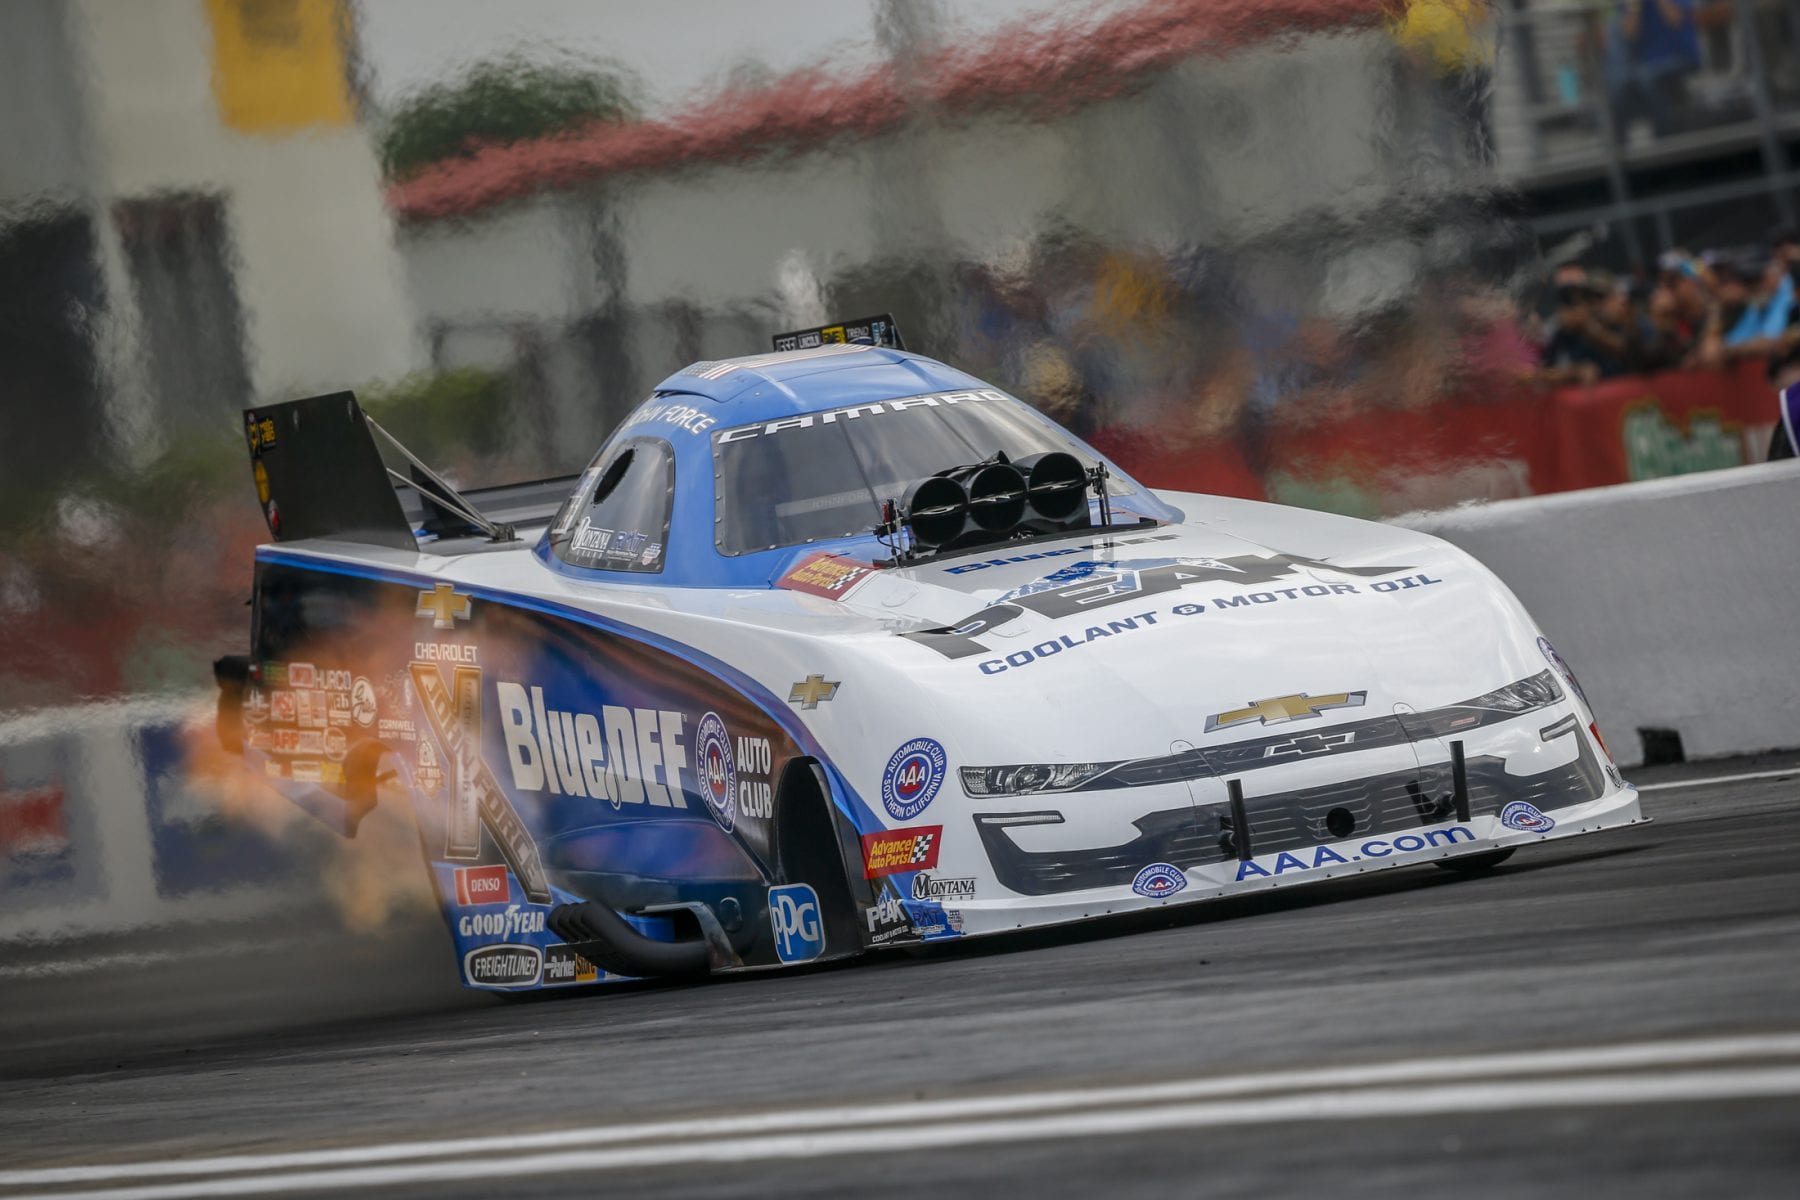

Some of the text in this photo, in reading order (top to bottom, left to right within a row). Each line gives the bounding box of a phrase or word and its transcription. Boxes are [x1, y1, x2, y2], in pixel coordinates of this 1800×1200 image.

[658, 405, 716, 434] FORCE
[978, 610, 1158, 675] COOLANT
[1211, 584, 1362, 610] MOTOR
[1369, 574, 1442, 593] OIL
[414, 642, 478, 663] CHEVROLET
[708, 755, 725, 785] AAA
[737, 736, 771, 775] AUTO
[887, 740, 945, 774] AUTOMOBILE CLUB
[897, 765, 926, 788] AAA
[740, 781, 772, 819] CLUB
[882, 771, 943, 818] SOUTHERN CALIFORNIA
[867, 852, 909, 870] Auto Parts
[870, 838, 912, 857] Advance
[1235, 826, 1477, 882] AAA.com
[471, 877, 500, 893] DENSO
[912, 872, 976, 900] MONTANA
[771, 895, 819, 956] PPG
[866, 898, 906, 933] PEAK
[474, 954, 537, 978] FREIGHTLINER
[550, 954, 576, 978] Parker
